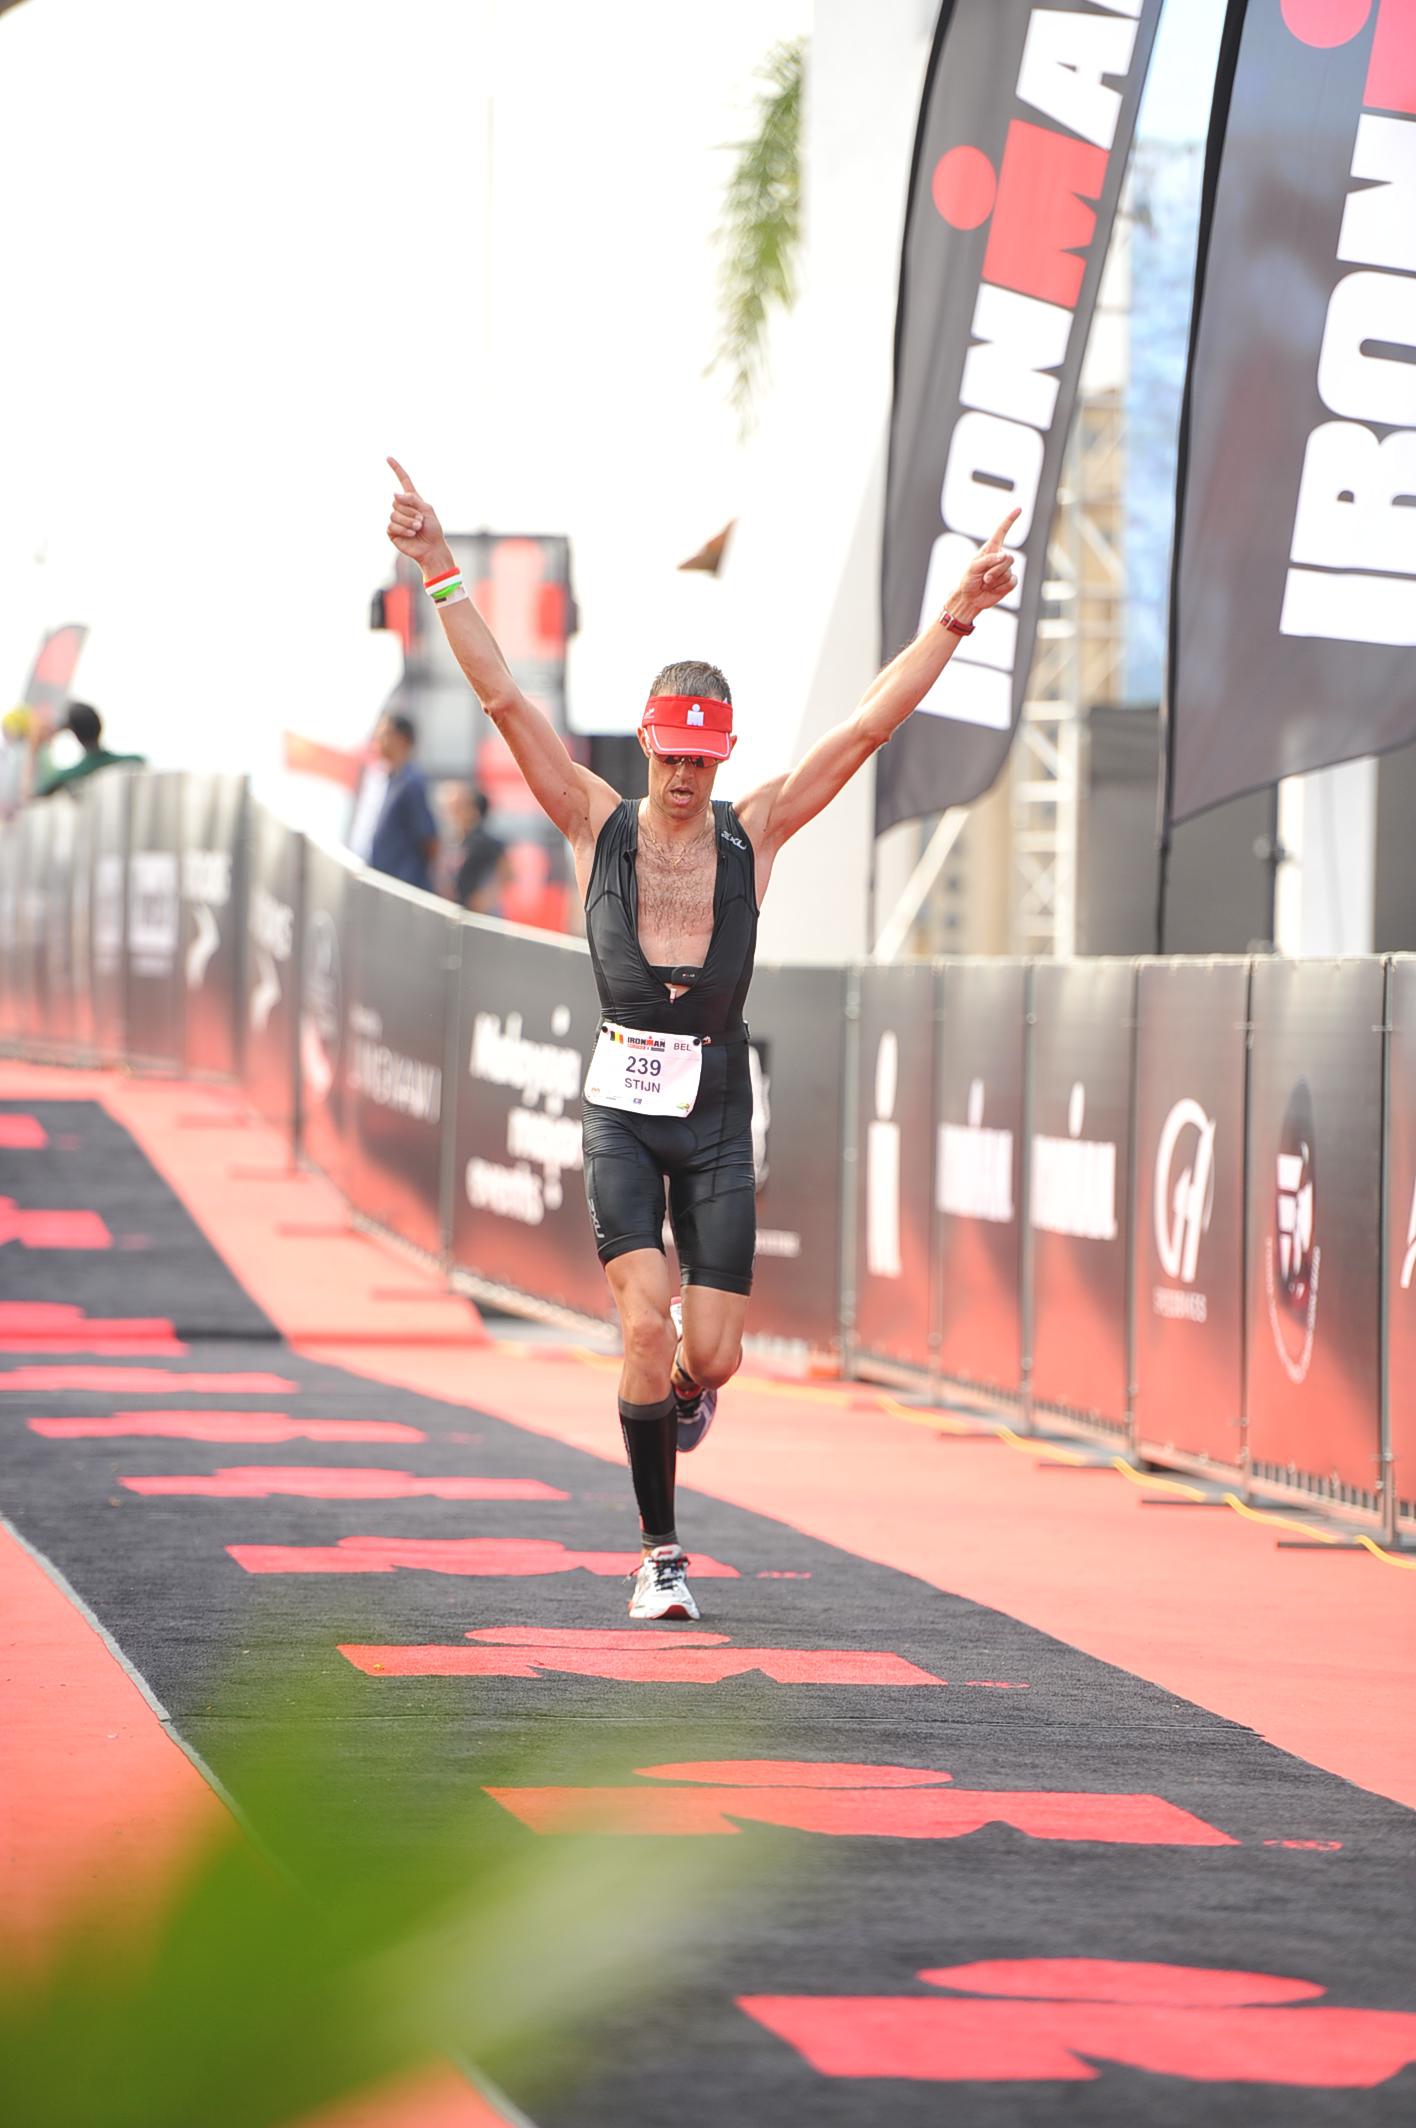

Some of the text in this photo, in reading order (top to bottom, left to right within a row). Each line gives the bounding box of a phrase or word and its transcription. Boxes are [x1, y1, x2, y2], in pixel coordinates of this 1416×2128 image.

[917, 0, 1142, 731] IRONMA
[627, 1036, 666, 1047] IRONMAN
[673, 1042, 691, 1051] BEL
[626, 1055, 662, 1077] 239
[624, 1077, 661, 1093] STIJN
